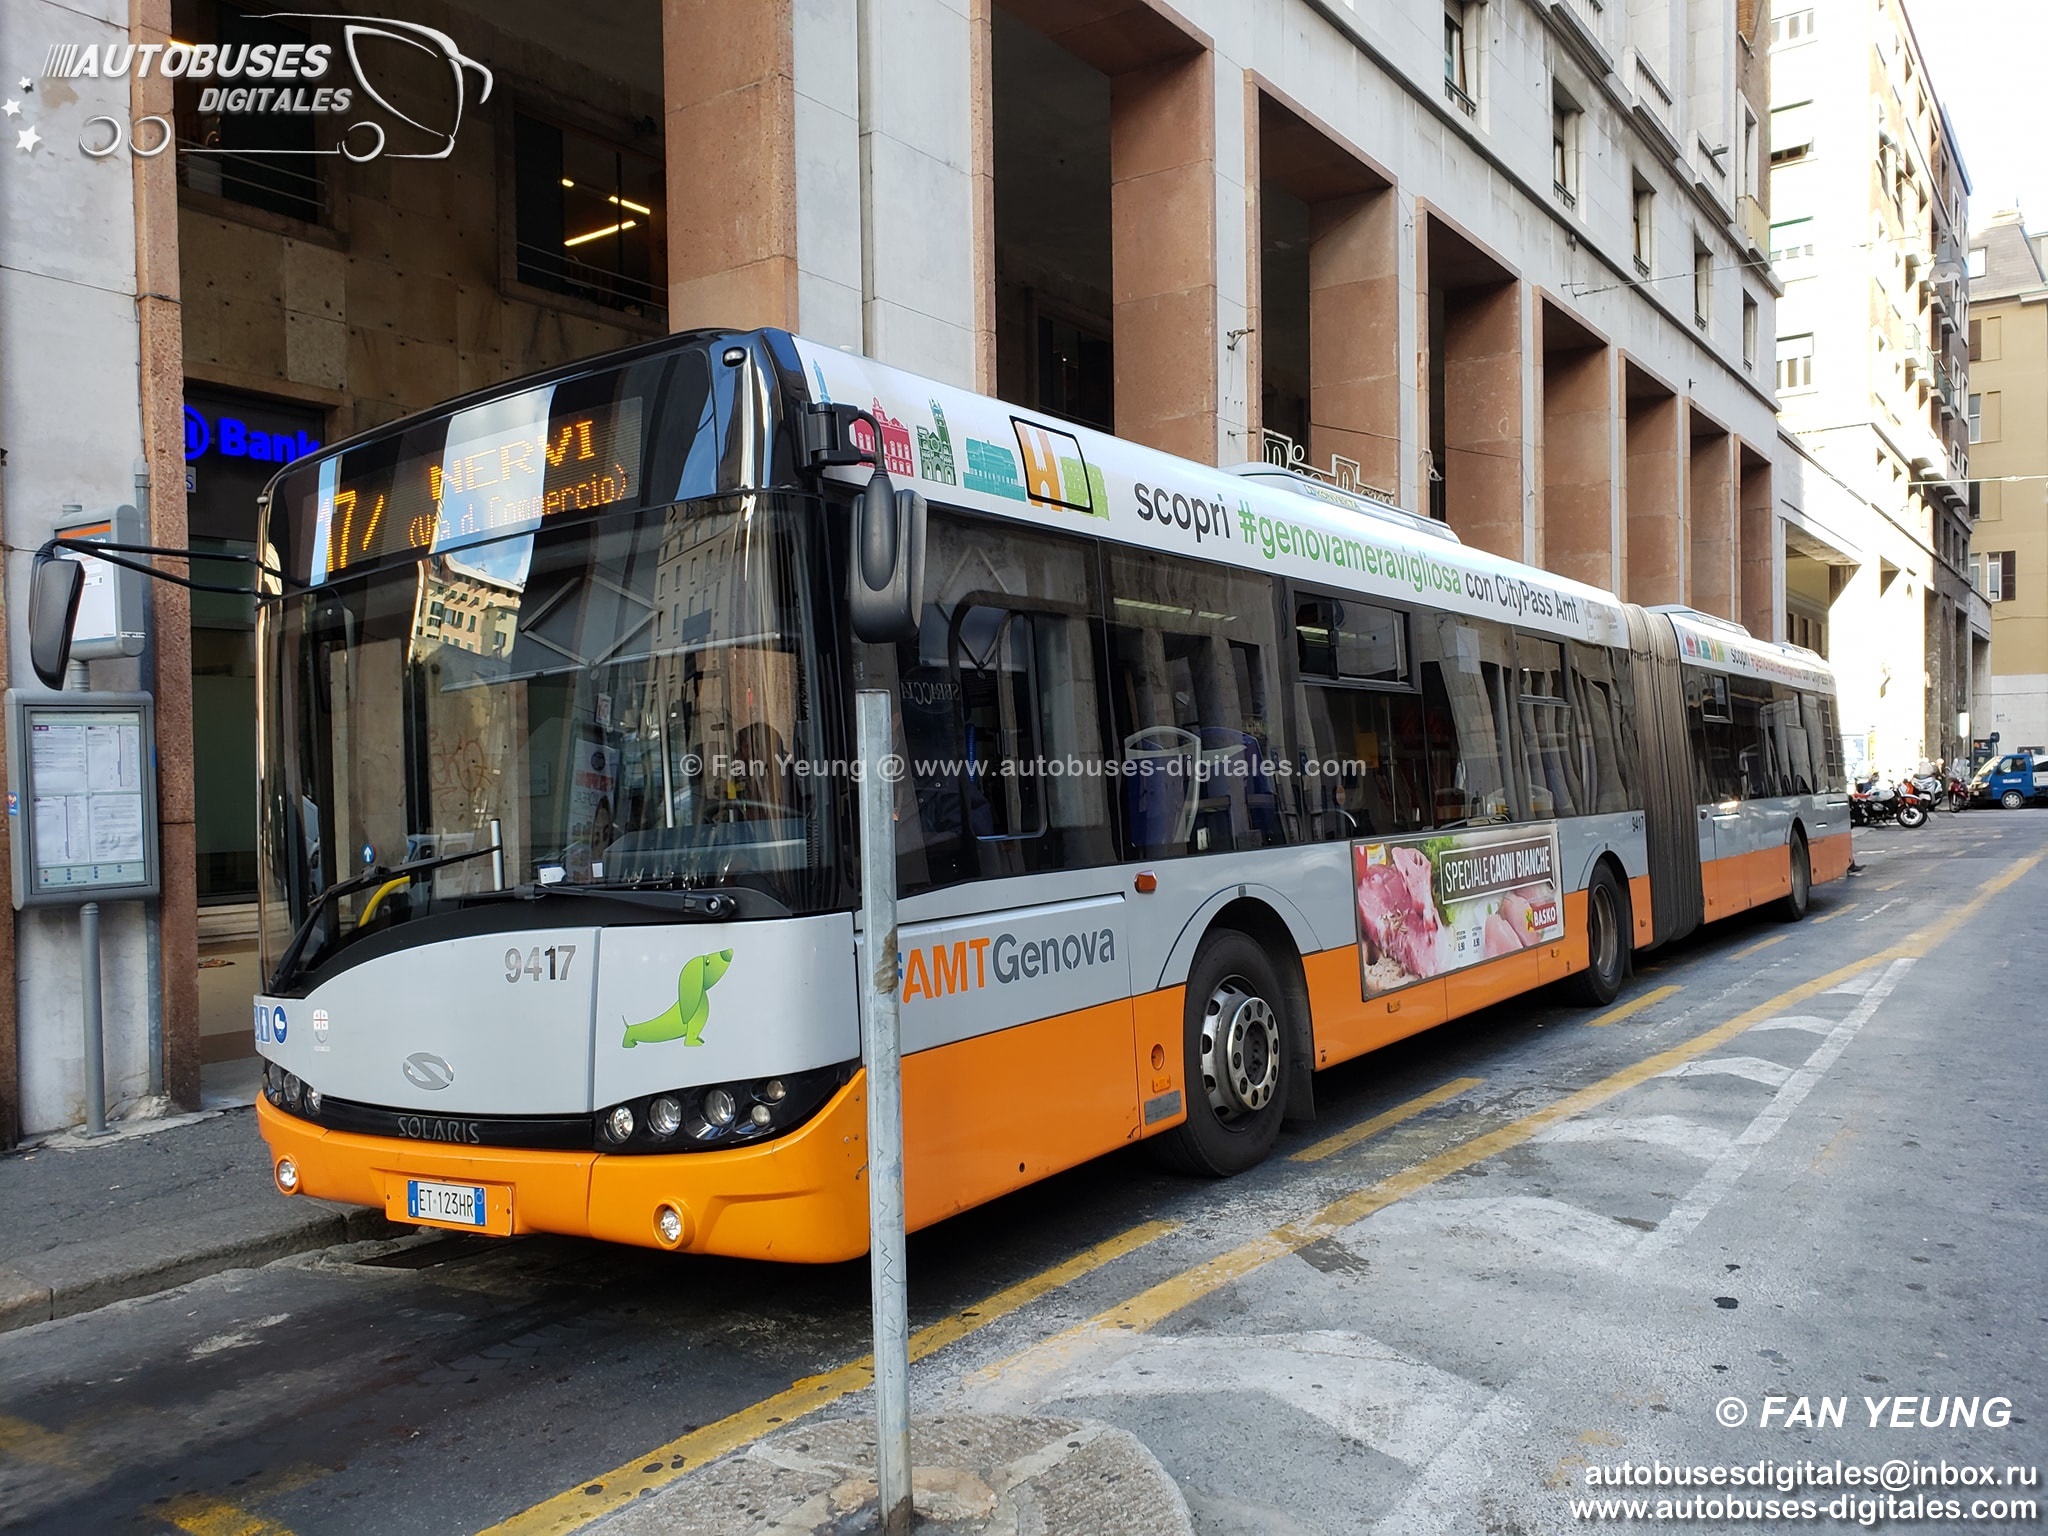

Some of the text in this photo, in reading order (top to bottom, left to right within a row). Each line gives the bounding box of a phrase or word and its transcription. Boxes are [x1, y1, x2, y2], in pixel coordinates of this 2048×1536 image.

[219, 416, 321, 464] Bank
[429, 420, 595, 501] NERVI
[1134, 482, 1231, 543] scopri
[1238, 499, 1463, 596] #genovameravigliosa
[1465, 571, 1494, 603] con
[1499, 573, 1553, 618] CityPass
[1554, 591, 1580, 625] Amt
[1445, 846, 1551, 893] SPECIALE CARNI BIANCHE
[1533, 906, 1556, 927] BASKO
[504, 944, 577, 984] 9417
[397, 1116, 480, 1144] SOLARIS
